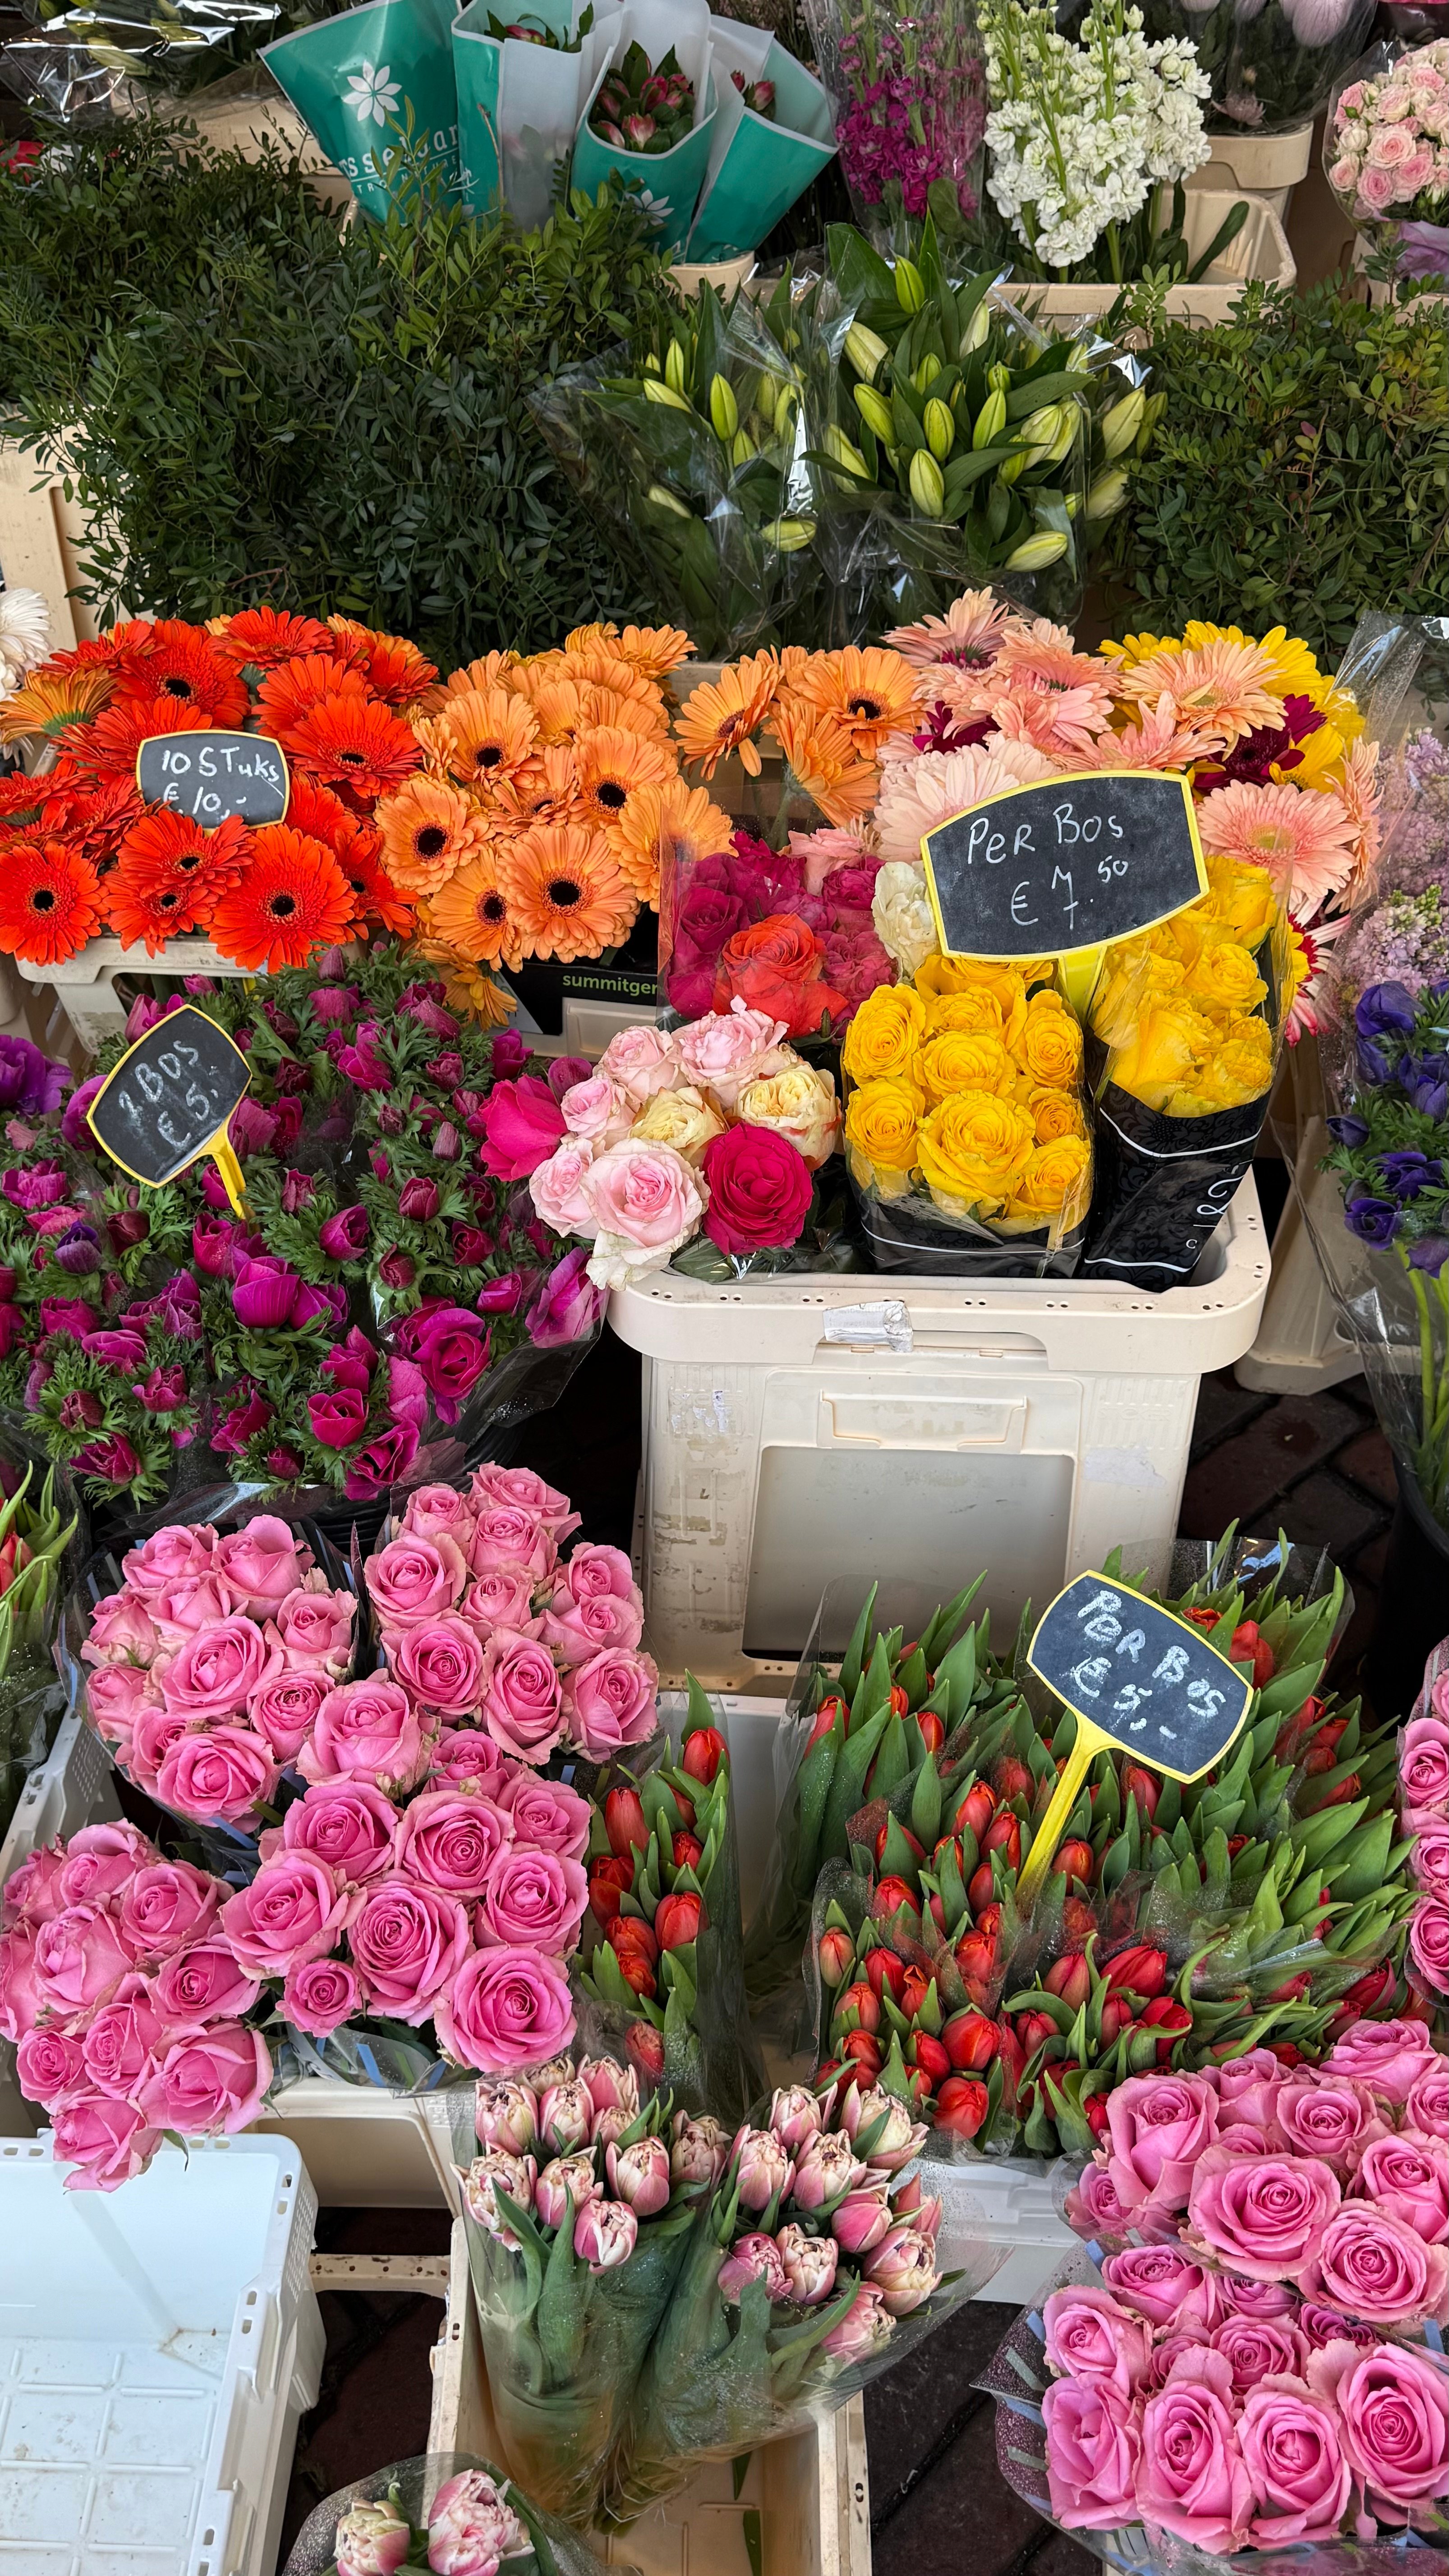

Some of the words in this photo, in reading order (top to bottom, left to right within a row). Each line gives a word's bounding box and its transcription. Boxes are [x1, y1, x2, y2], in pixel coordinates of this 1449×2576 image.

[161, 750, 191, 775] 10
[1011, 881, 1039, 926] €
[157, 1111, 192, 1149] €
[1072, 1655, 1112, 1698] €
